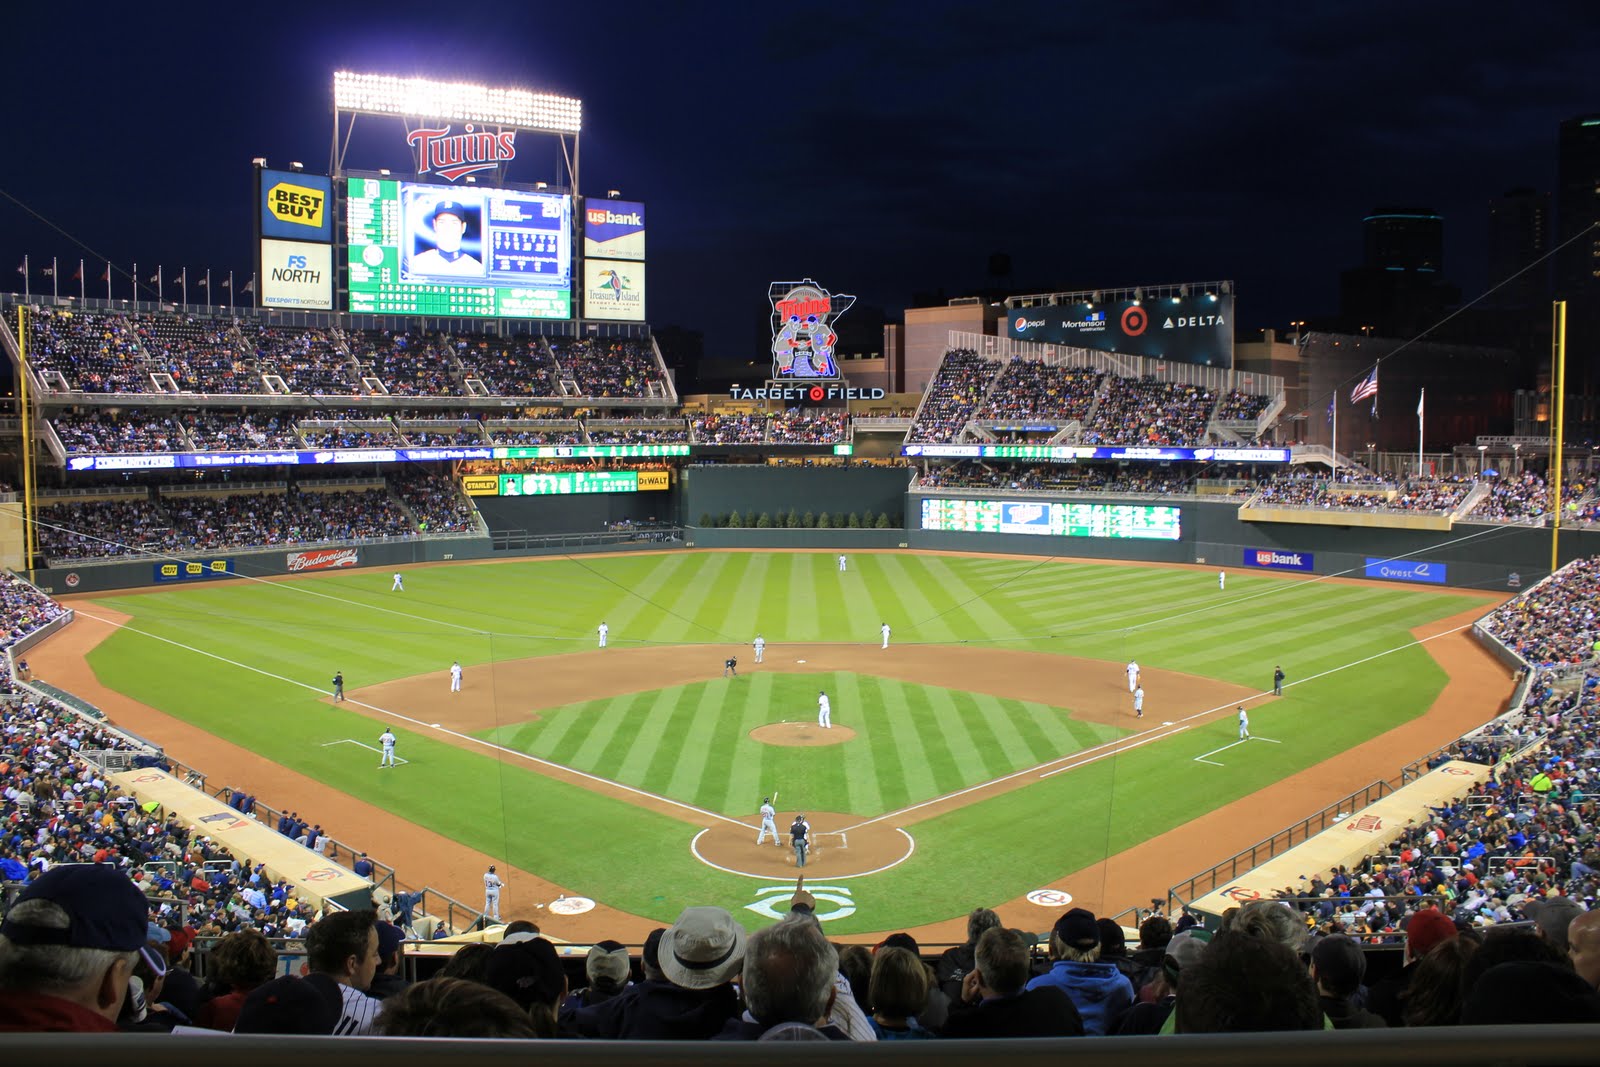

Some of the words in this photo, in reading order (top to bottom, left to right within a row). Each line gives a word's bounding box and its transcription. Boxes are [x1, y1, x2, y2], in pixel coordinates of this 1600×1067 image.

[407, 124, 516, 175] Twins
[275, 189, 323, 209] BEST
[276, 202, 318, 220] BUY
[287, 255, 307, 269] FS
[271, 268, 320, 284] NORTH
[589, 289, 615, 301] Treasure
[621, 291, 640, 302] Island
[775, 296, 831, 323] Twins
[1027, 319, 1046, 328] pepsi
[1062, 320, 1105, 329] Mortenson
[1177, 315, 1225, 328] DELTA
[730, 388, 807, 400] TARGET
[828, 388, 885, 400] FIELD
[294, 550, 353, 571] Budweiser
[1380, 567, 1412, 578] Qwest
